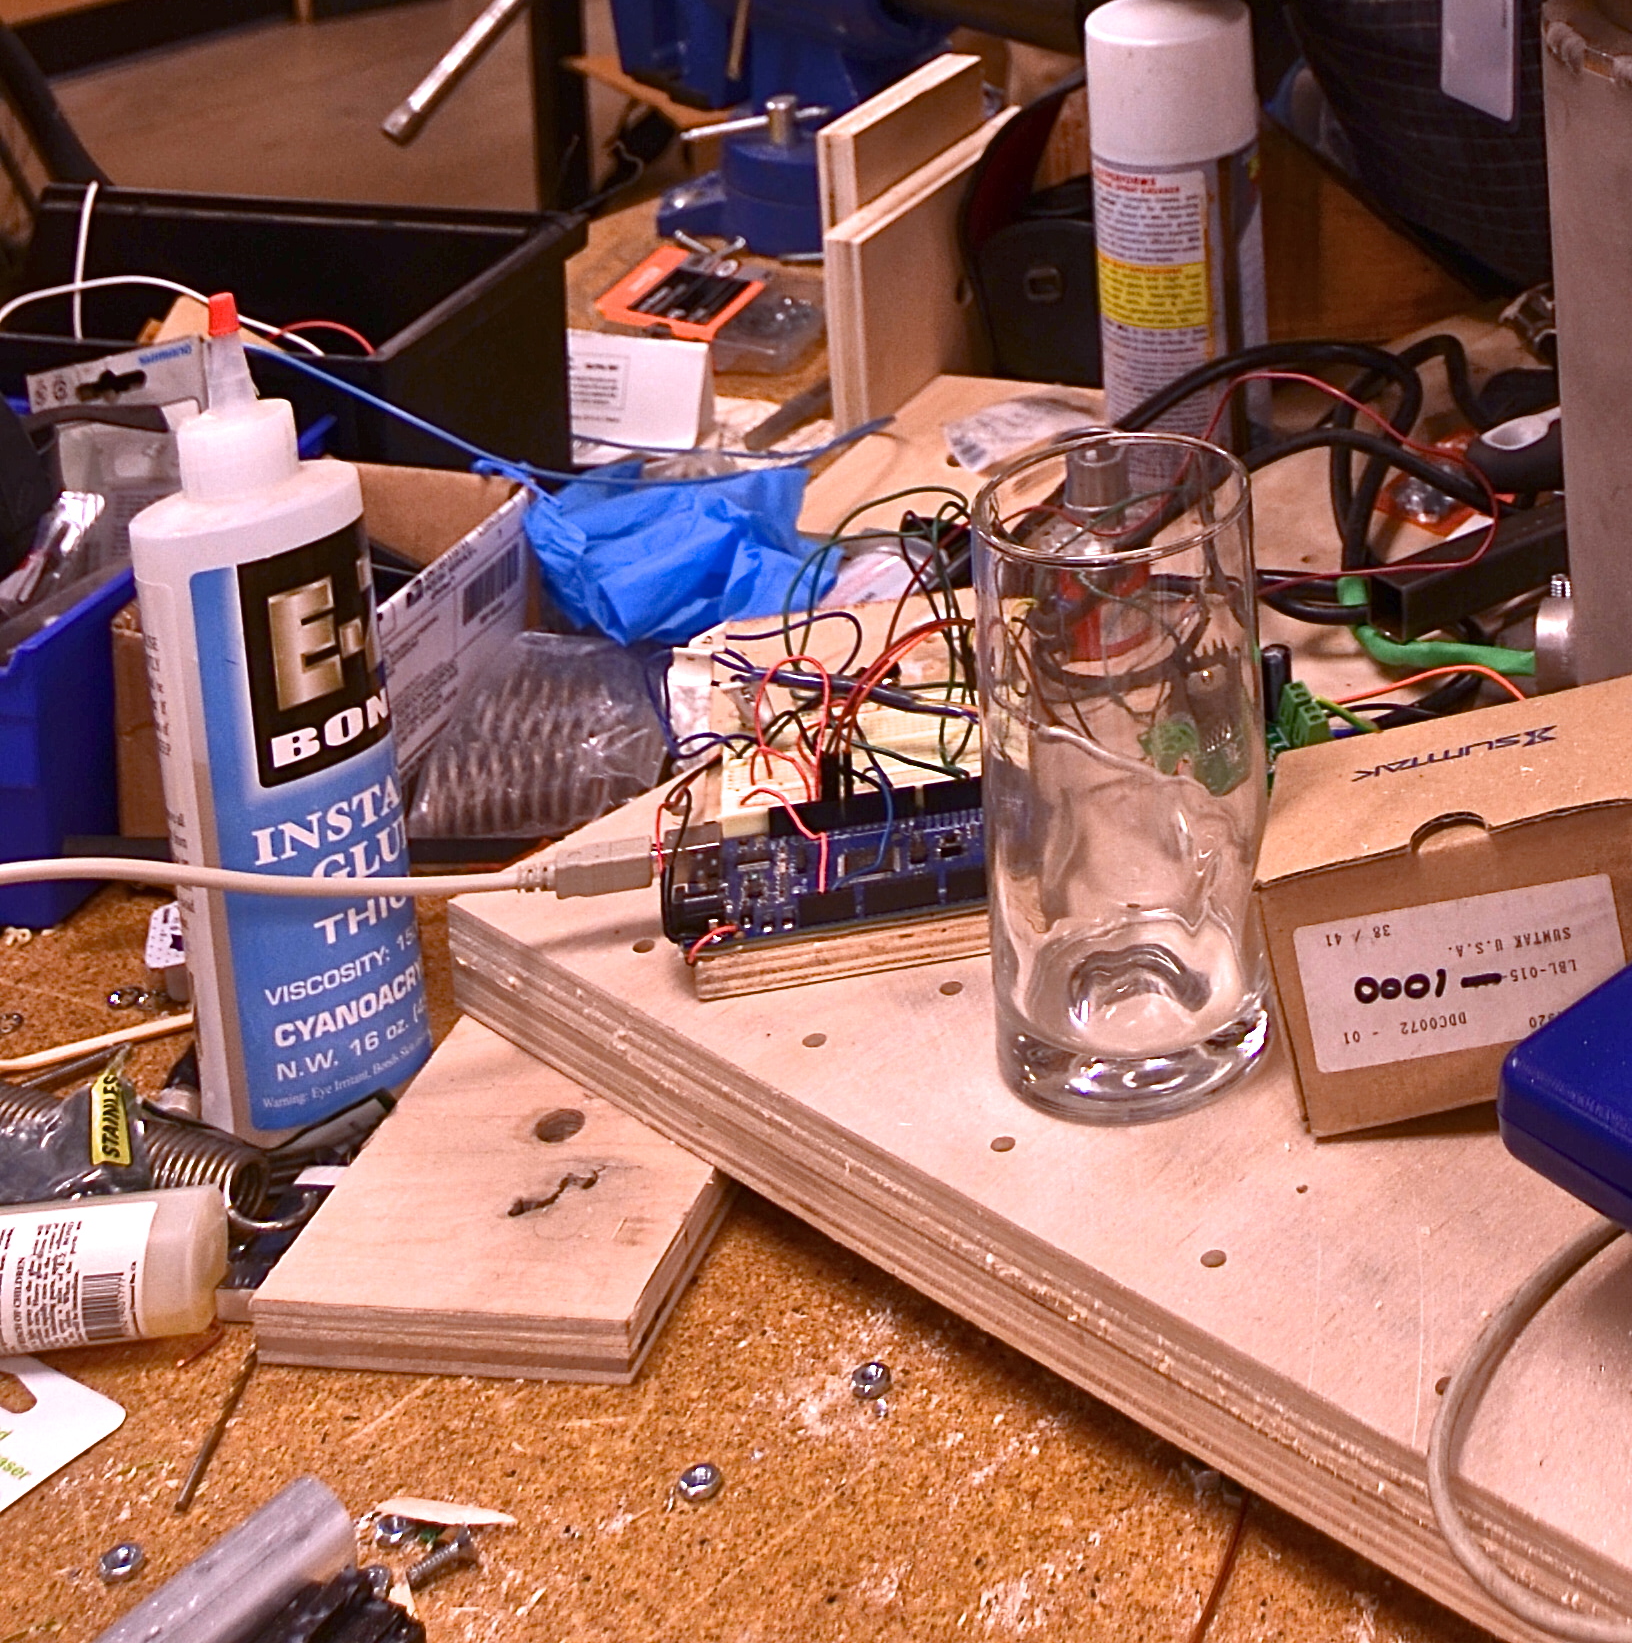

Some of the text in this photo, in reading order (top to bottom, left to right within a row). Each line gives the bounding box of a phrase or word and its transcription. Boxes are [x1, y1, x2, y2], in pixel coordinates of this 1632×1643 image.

[1325, 933, 1342, 947] 41
[1372, 924, 1391, 939] 38
[264, 945, 391, 1006] VISCOSITY:
[1400, 1011, 1467, 1035] DDC0072
[1344, 1030, 1361, 1045] 01
[276, 1049, 339, 1082] N.W.
[349, 1030, 380, 1056] 16
